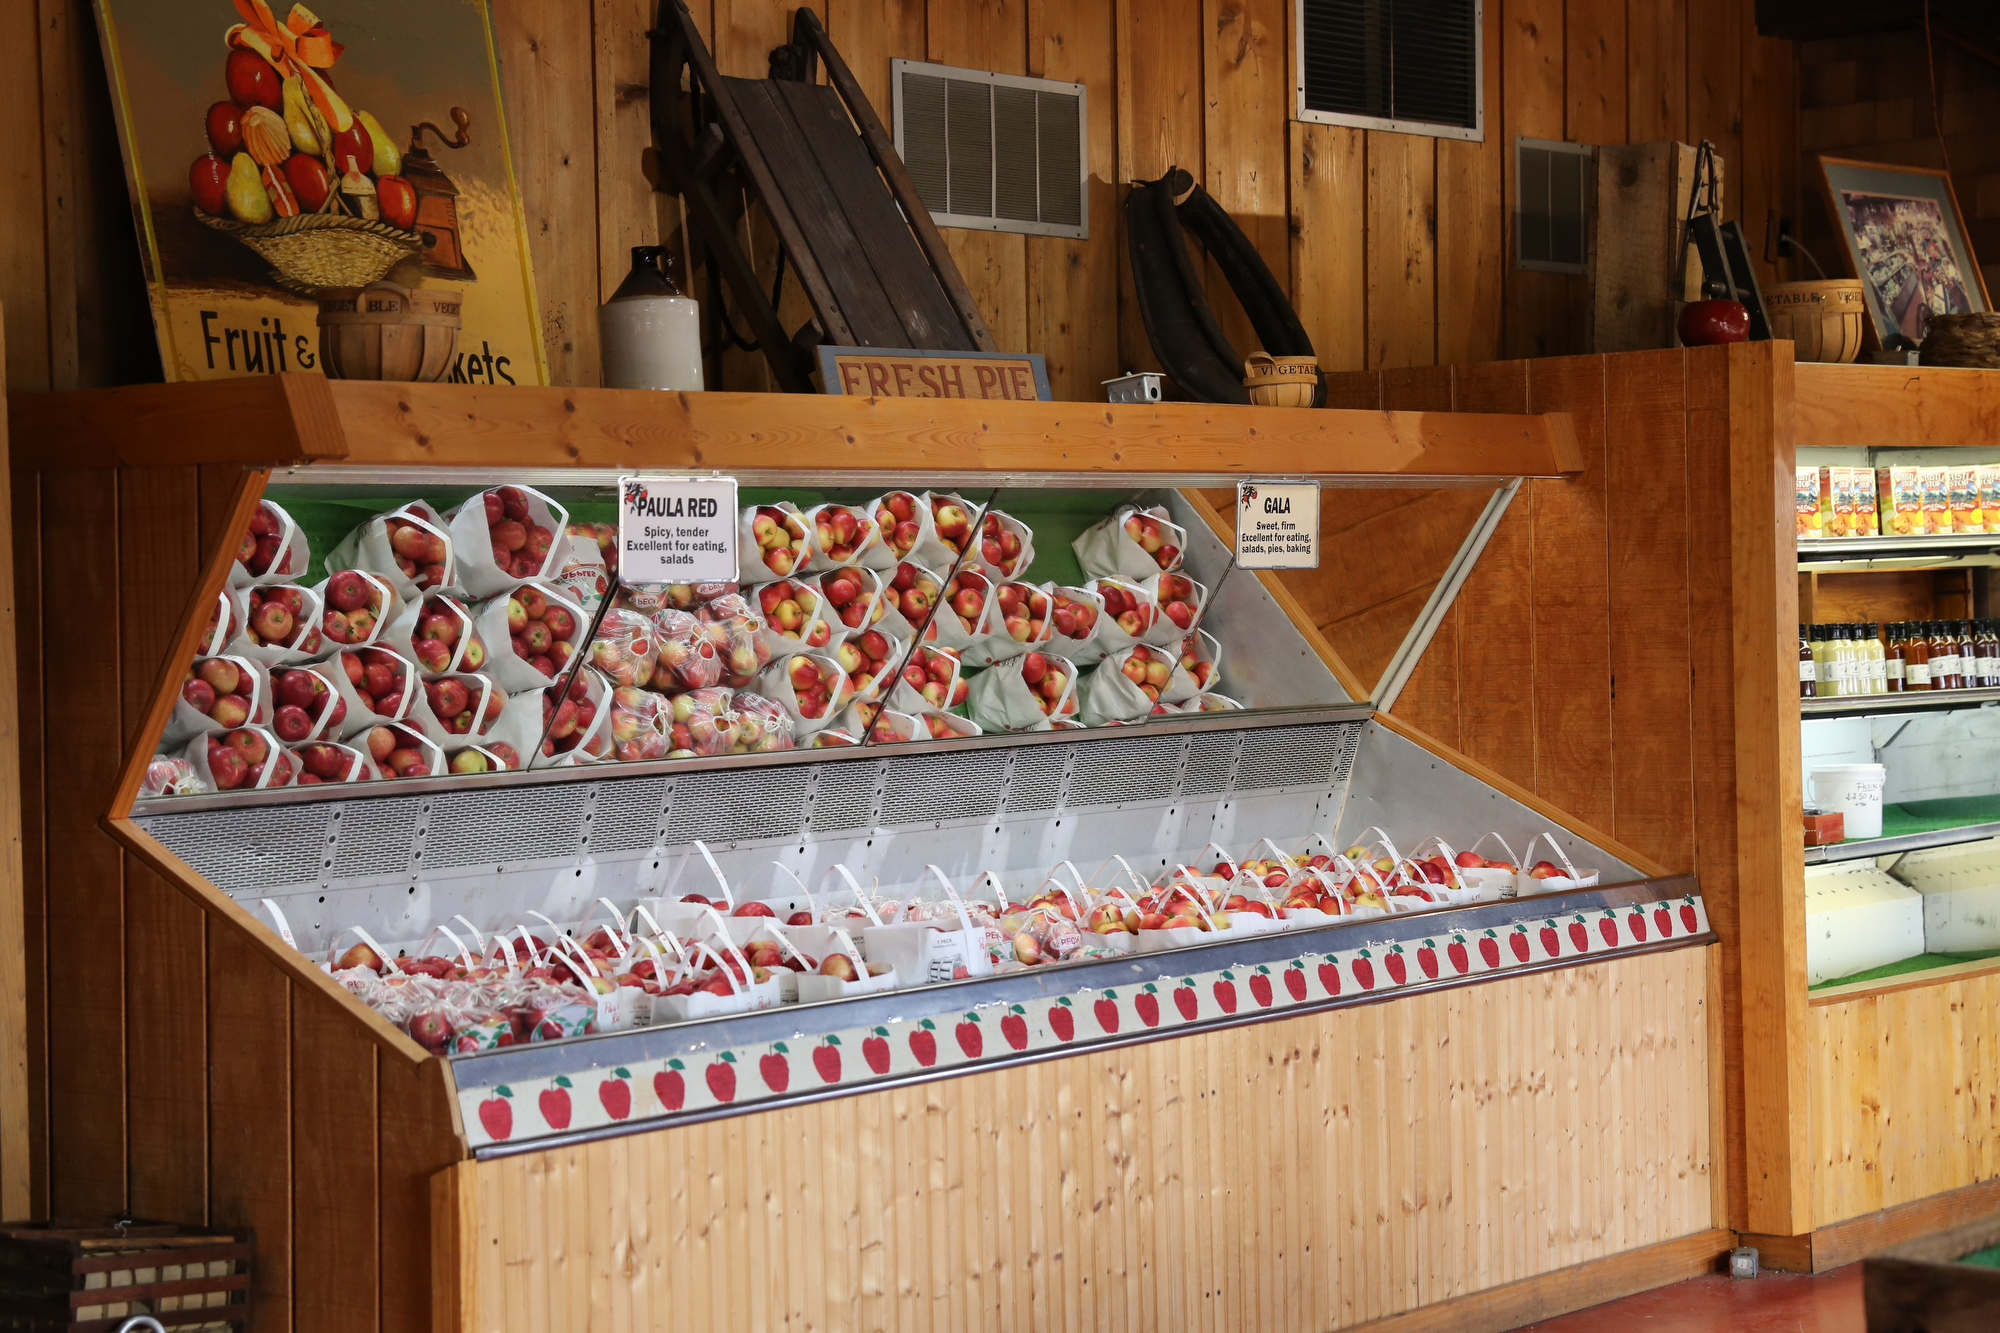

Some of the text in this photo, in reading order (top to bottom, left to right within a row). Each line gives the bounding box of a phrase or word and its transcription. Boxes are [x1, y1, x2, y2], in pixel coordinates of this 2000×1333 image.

[1765, 292, 1820, 305] ETABLE
[200, 310, 516, 386] Fruit & kets
[839, 362, 1036, 400] FRESH PIE
[1950, 472, 1977, 482] HISTLE
[638, 497, 718, 518] PAULA RED
[1264, 497, 1290, 514] GALA
[644, 526, 709, 539] Spicy, tender
[1256, 521, 1295, 531] Sweet, firm
[1242, 533, 1311, 543] Excellent for eating,
[627, 540, 727, 553] Excellent for eating,
[1242, 544, 1311, 554] salads, pies, baking
[660, 554, 694, 564] salads
